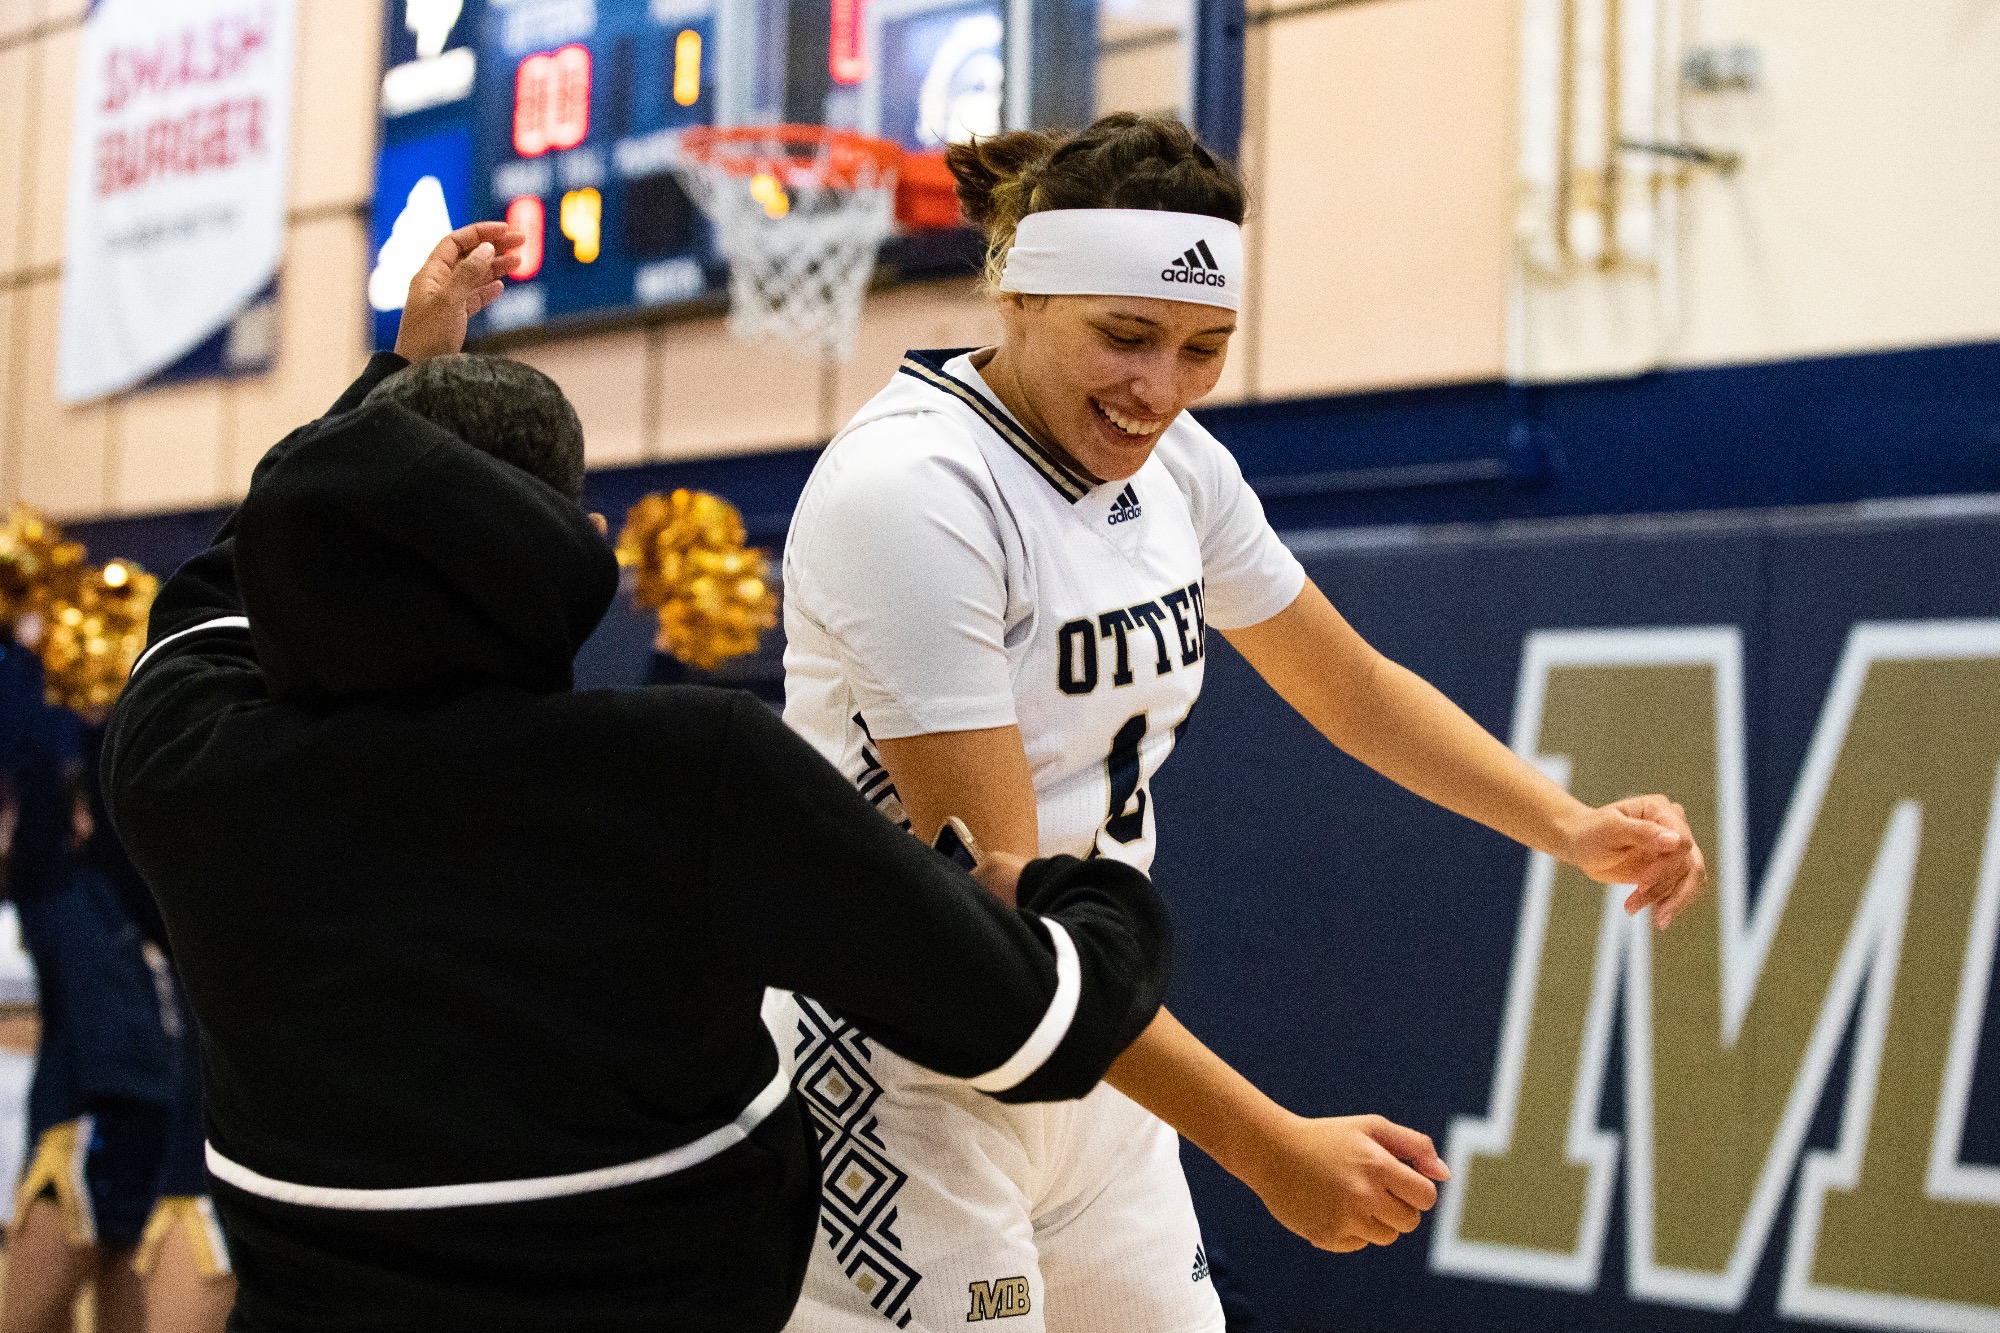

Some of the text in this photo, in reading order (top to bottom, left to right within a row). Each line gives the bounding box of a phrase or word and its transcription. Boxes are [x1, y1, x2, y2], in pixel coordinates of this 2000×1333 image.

[95, 93, 269, 199] BURGER
[1161, 266, 1226, 288] adidas
[967, 1275, 1031, 1323] MB
